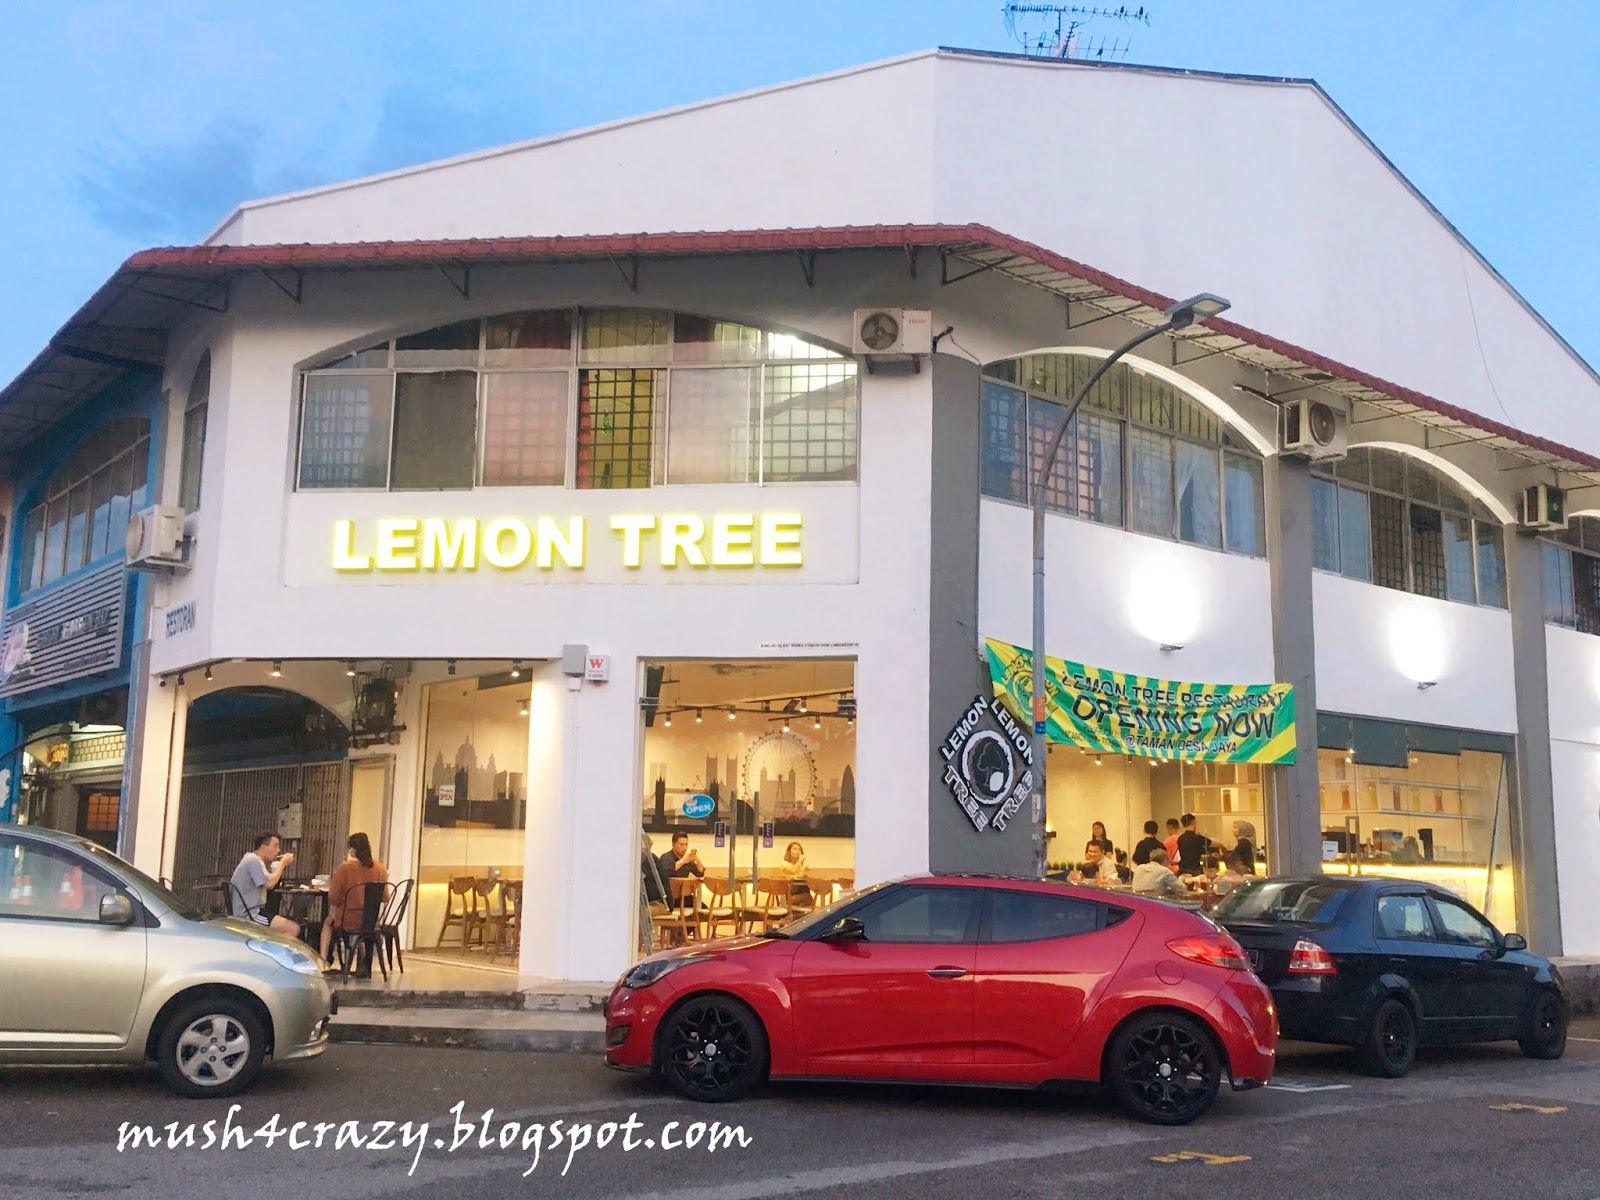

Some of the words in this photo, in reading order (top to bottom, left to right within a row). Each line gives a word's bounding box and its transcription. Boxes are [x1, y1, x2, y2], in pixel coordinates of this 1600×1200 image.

[332, 515, 587, 571] LEMON
[609, 512, 804, 568] TREE
[165, 601, 196, 638] RESTORAN
[1061, 671, 1129, 700] LEMON
[1131, 685, 1179, 707] TREE
[1181, 691, 1286, 709] RESTAURANT
[942, 695, 989, 761] LEMON
[990, 699, 1034, 765] LEMON
[1072, 694, 1203, 736] OPENING
[1213, 711, 1276, 739] NOW
[1124, 734, 1176, 750] @TAMAN
[1178, 740, 1209, 752] DESA
[1212, 742, 1239, 754] JAYA
[685, 803, 711, 815] OPEN
[944, 764, 989, 832] TREE
[992, 769, 1034, 832] TREE
